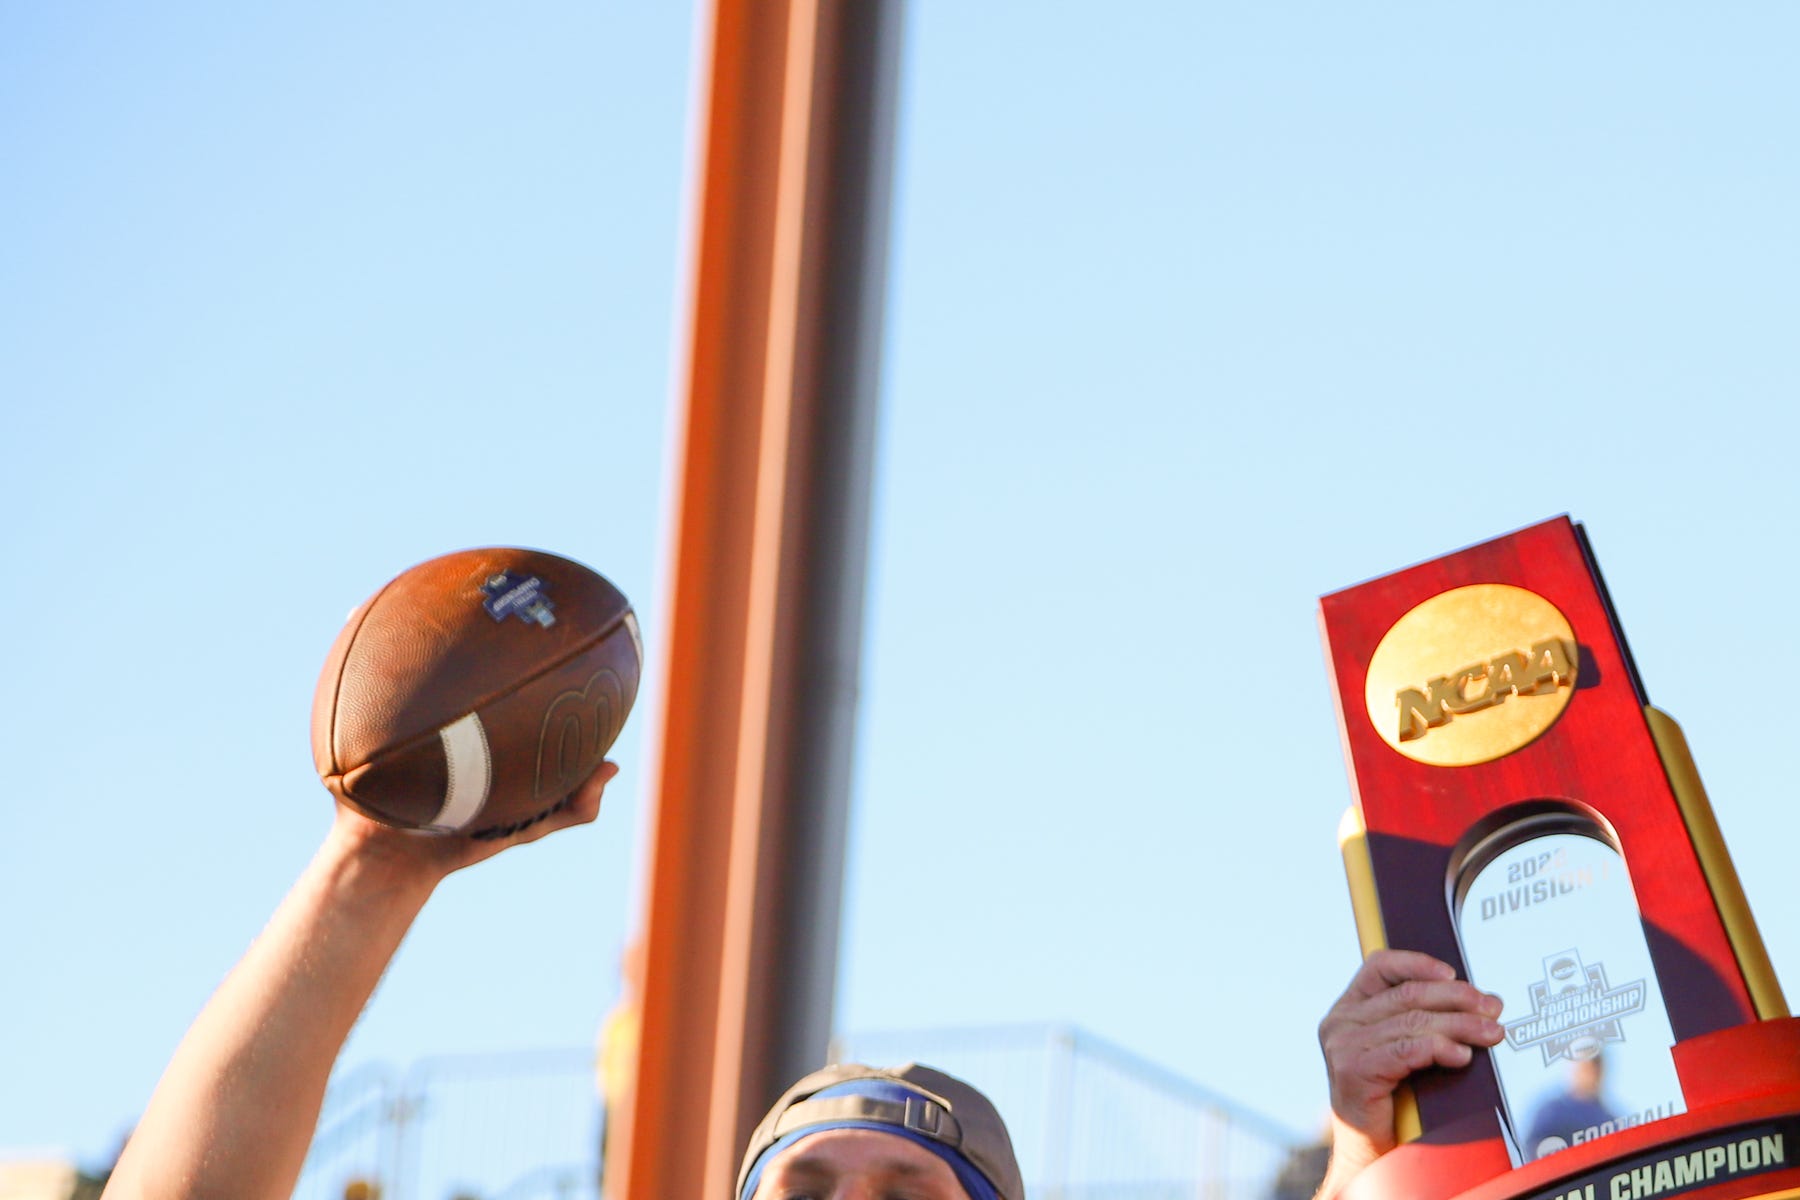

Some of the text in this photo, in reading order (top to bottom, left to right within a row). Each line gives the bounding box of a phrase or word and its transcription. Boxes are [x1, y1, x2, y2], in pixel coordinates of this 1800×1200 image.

[1395, 638, 1571, 742] NCAA
[1481, 863, 1593, 921] DIVISION
[1514, 988, 1640, 1043] CHAMPIONSHIP
[1541, 988, 1604, 1019] FOOTBALL
